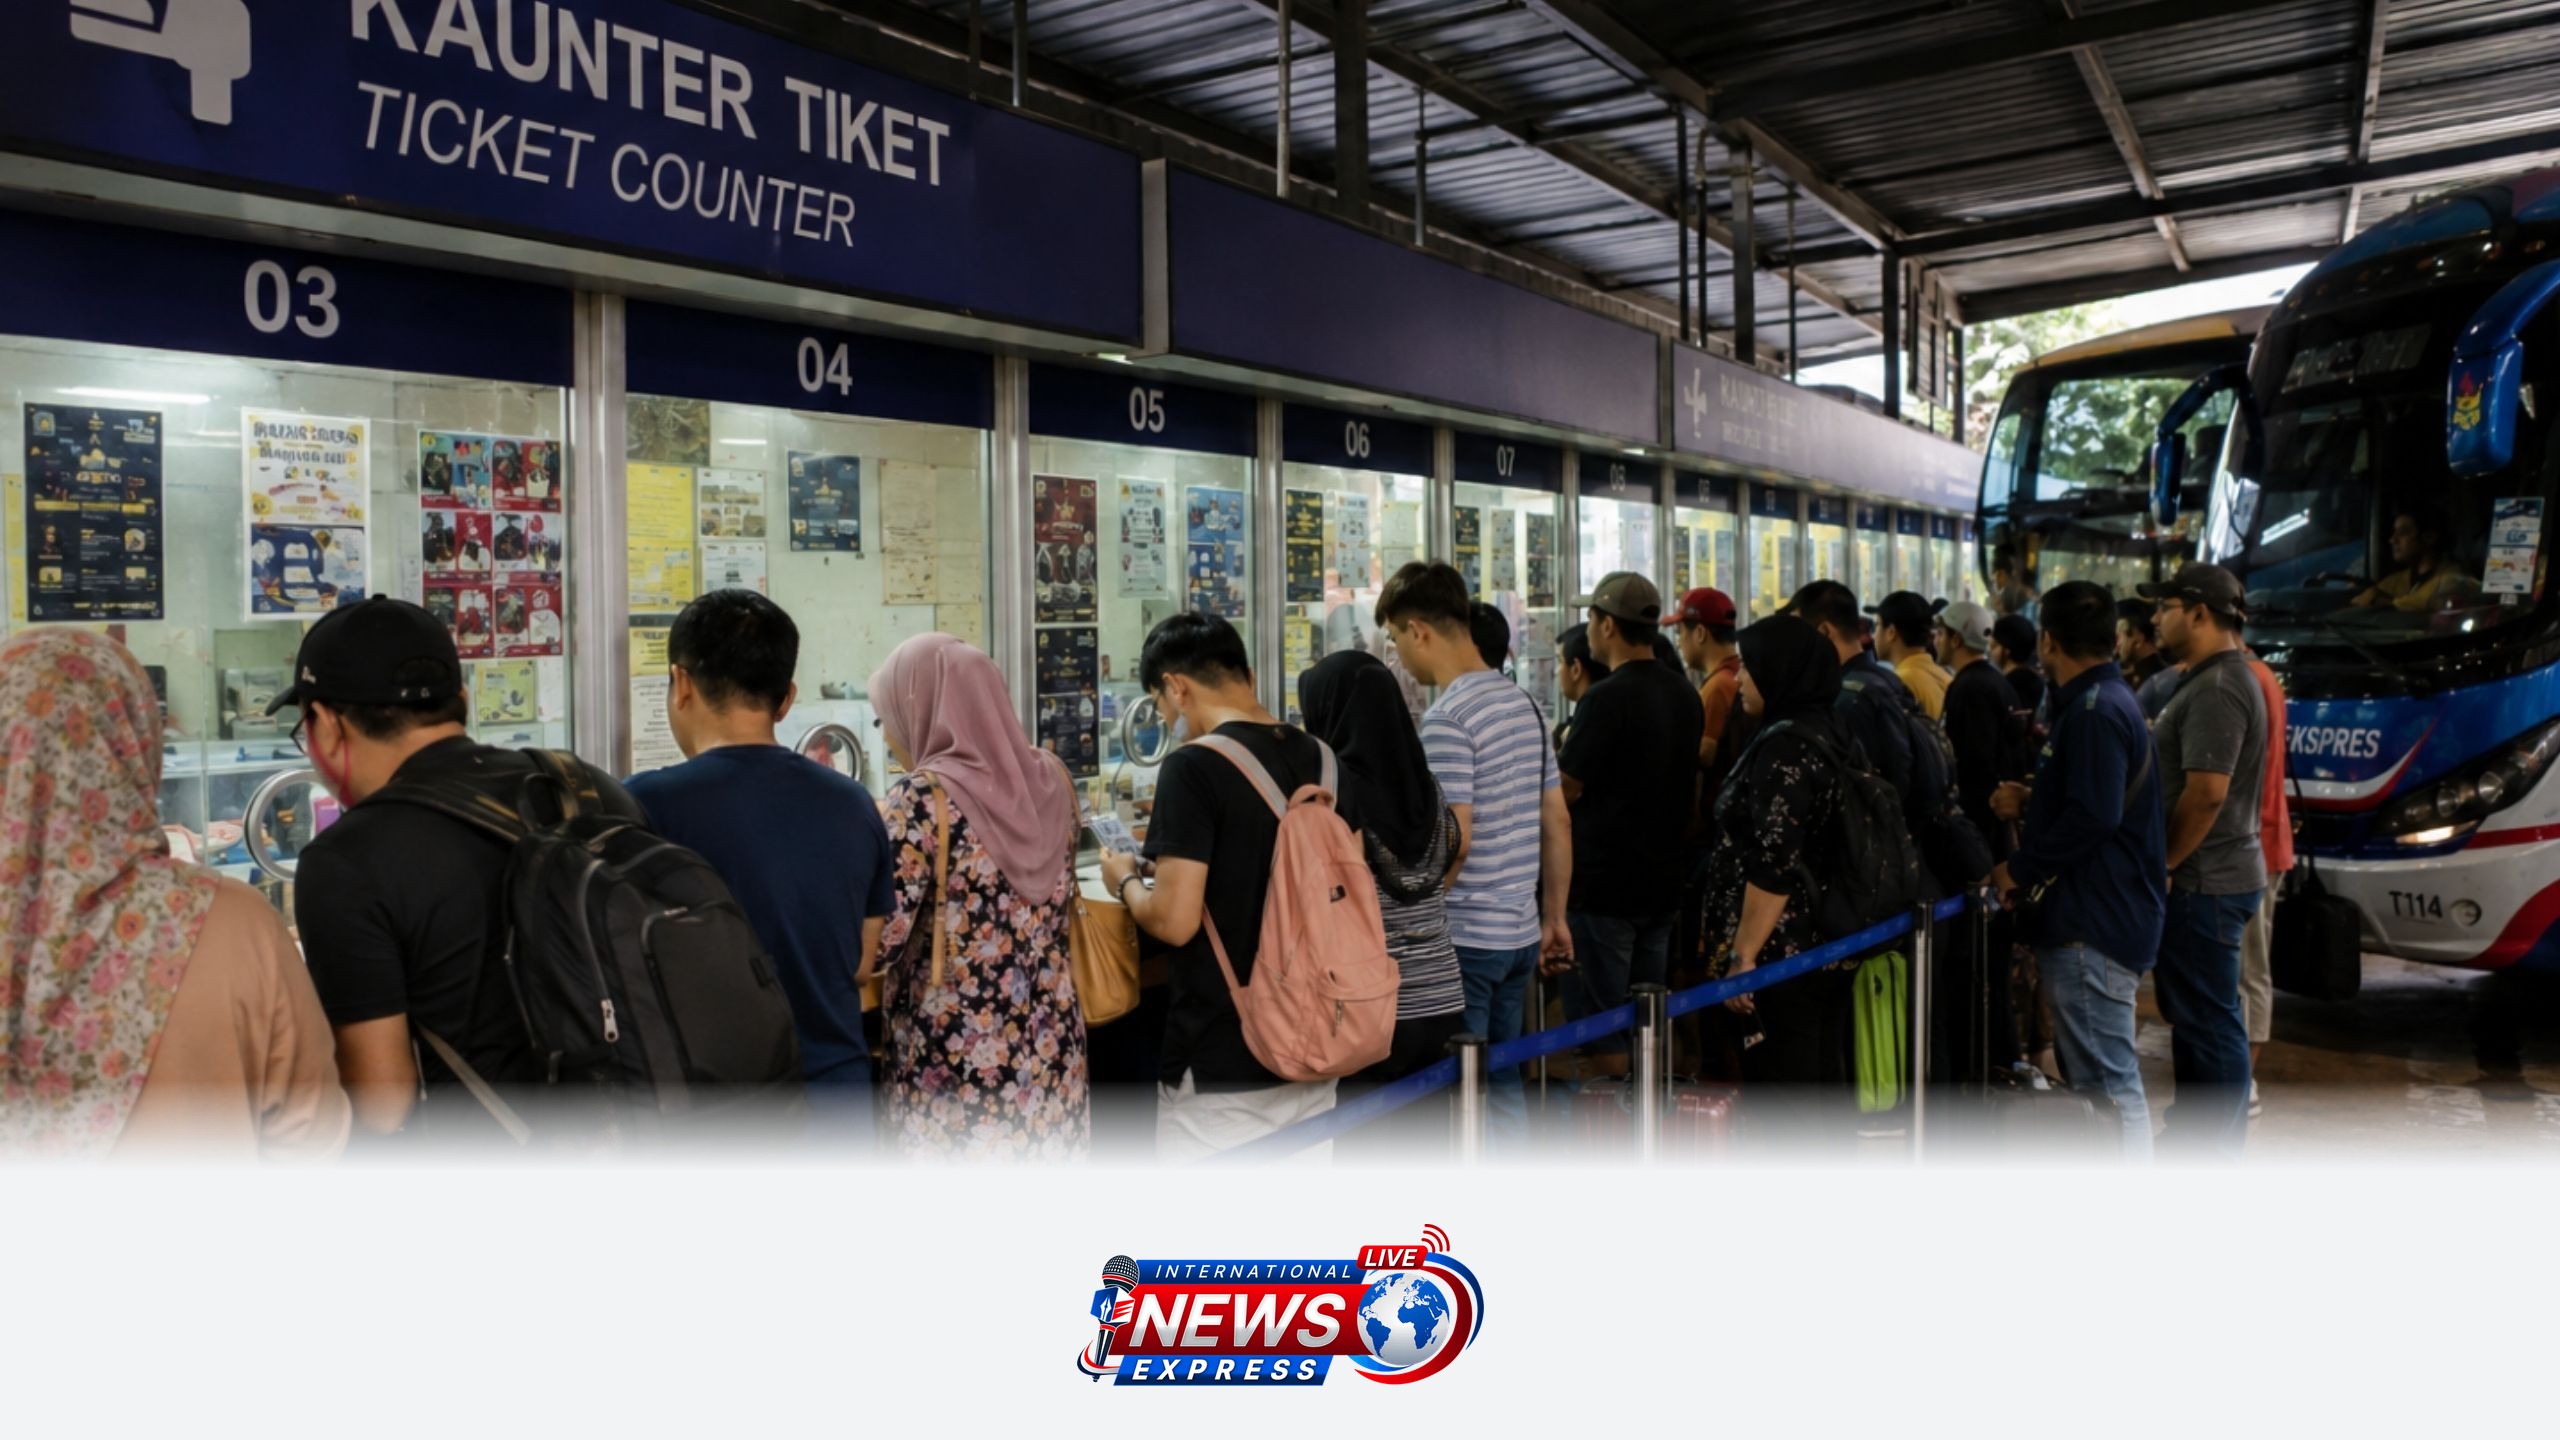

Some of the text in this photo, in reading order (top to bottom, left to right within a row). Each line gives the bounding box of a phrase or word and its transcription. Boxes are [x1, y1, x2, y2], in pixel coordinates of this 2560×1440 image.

[785, 75, 950, 187] TIKET
[358, 80, 856, 248] TICKET COUNTER
[243, 259, 341, 339] 03
[797, 336, 853, 396] 04
[1128, 386, 1166, 433] 05
[1345, 420, 1371, 459] 06
[1496, 444, 1515, 477] 07
[2387, 890, 2443, 918] T114
